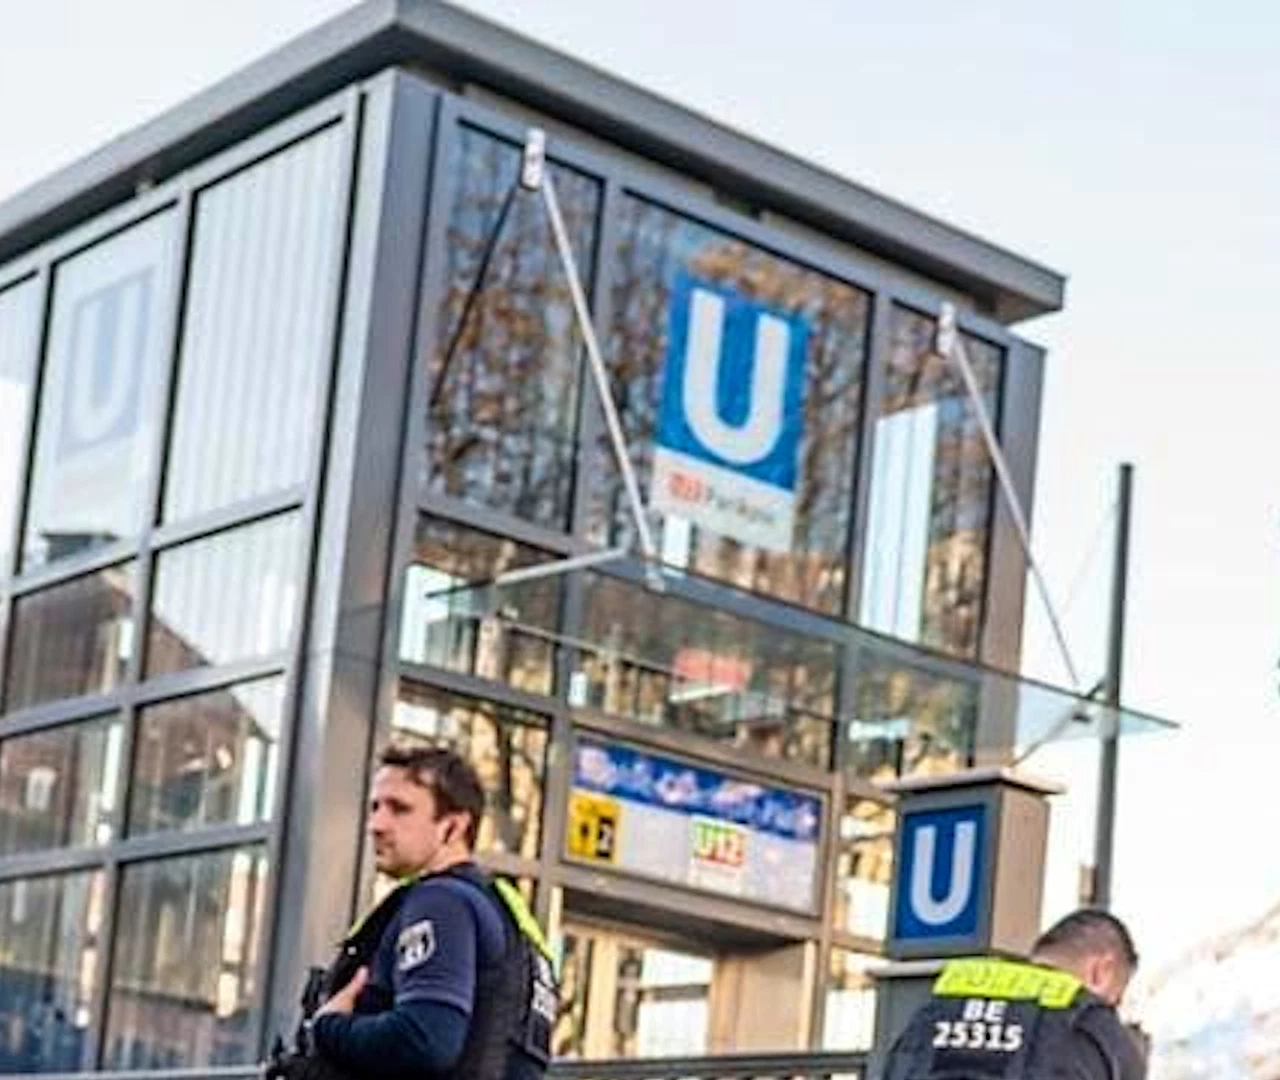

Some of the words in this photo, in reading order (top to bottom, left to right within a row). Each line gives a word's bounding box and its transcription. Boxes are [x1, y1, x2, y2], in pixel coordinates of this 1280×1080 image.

[69, 279, 146, 436] U
[683, 286, 791, 464] U
[910, 820, 977, 926] U
[931, 1021, 1023, 1050] 25315
[962, 998, 1009, 1021] BE
